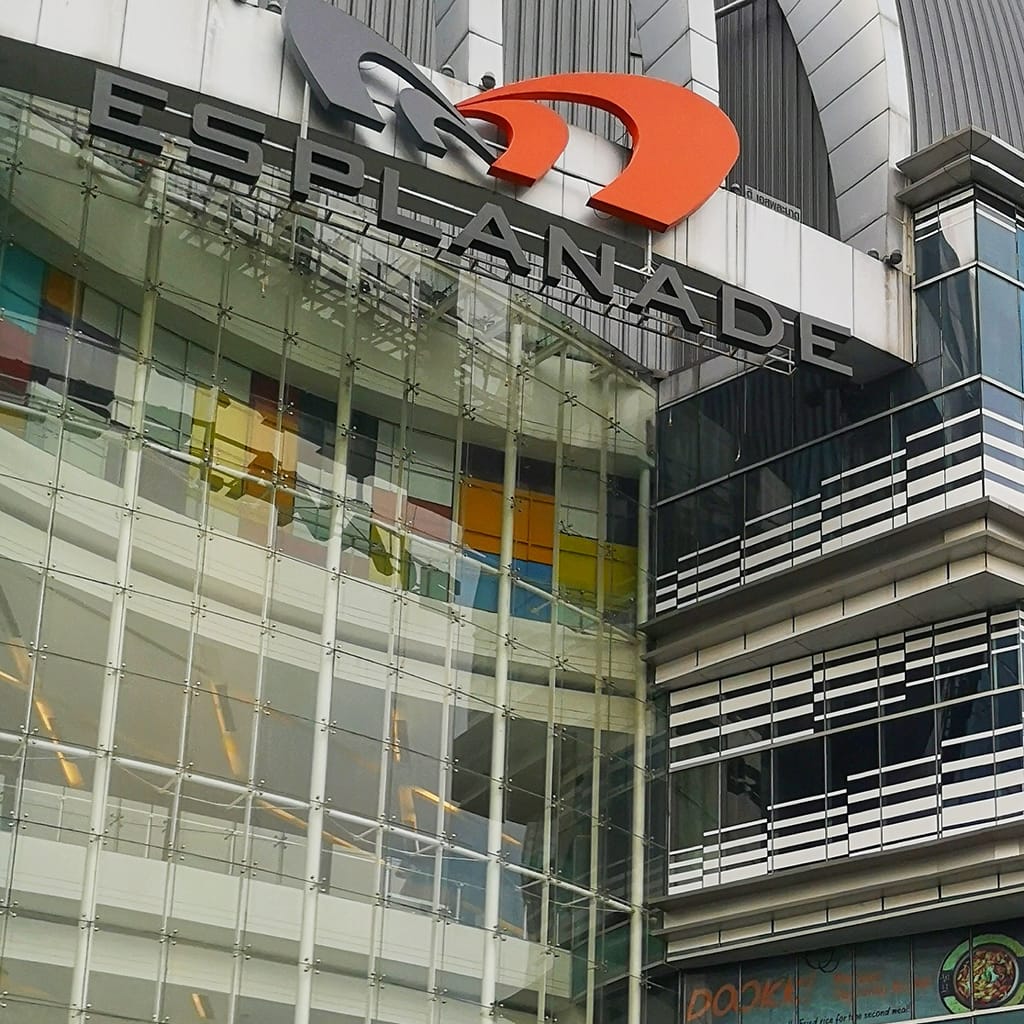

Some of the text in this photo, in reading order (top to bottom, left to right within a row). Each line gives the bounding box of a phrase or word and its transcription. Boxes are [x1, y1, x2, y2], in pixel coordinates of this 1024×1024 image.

[89, 69, 855, 377] ESPLANADE
[820, 1016, 833, 1024] rice
[864, 1006, 891, 1019] second
